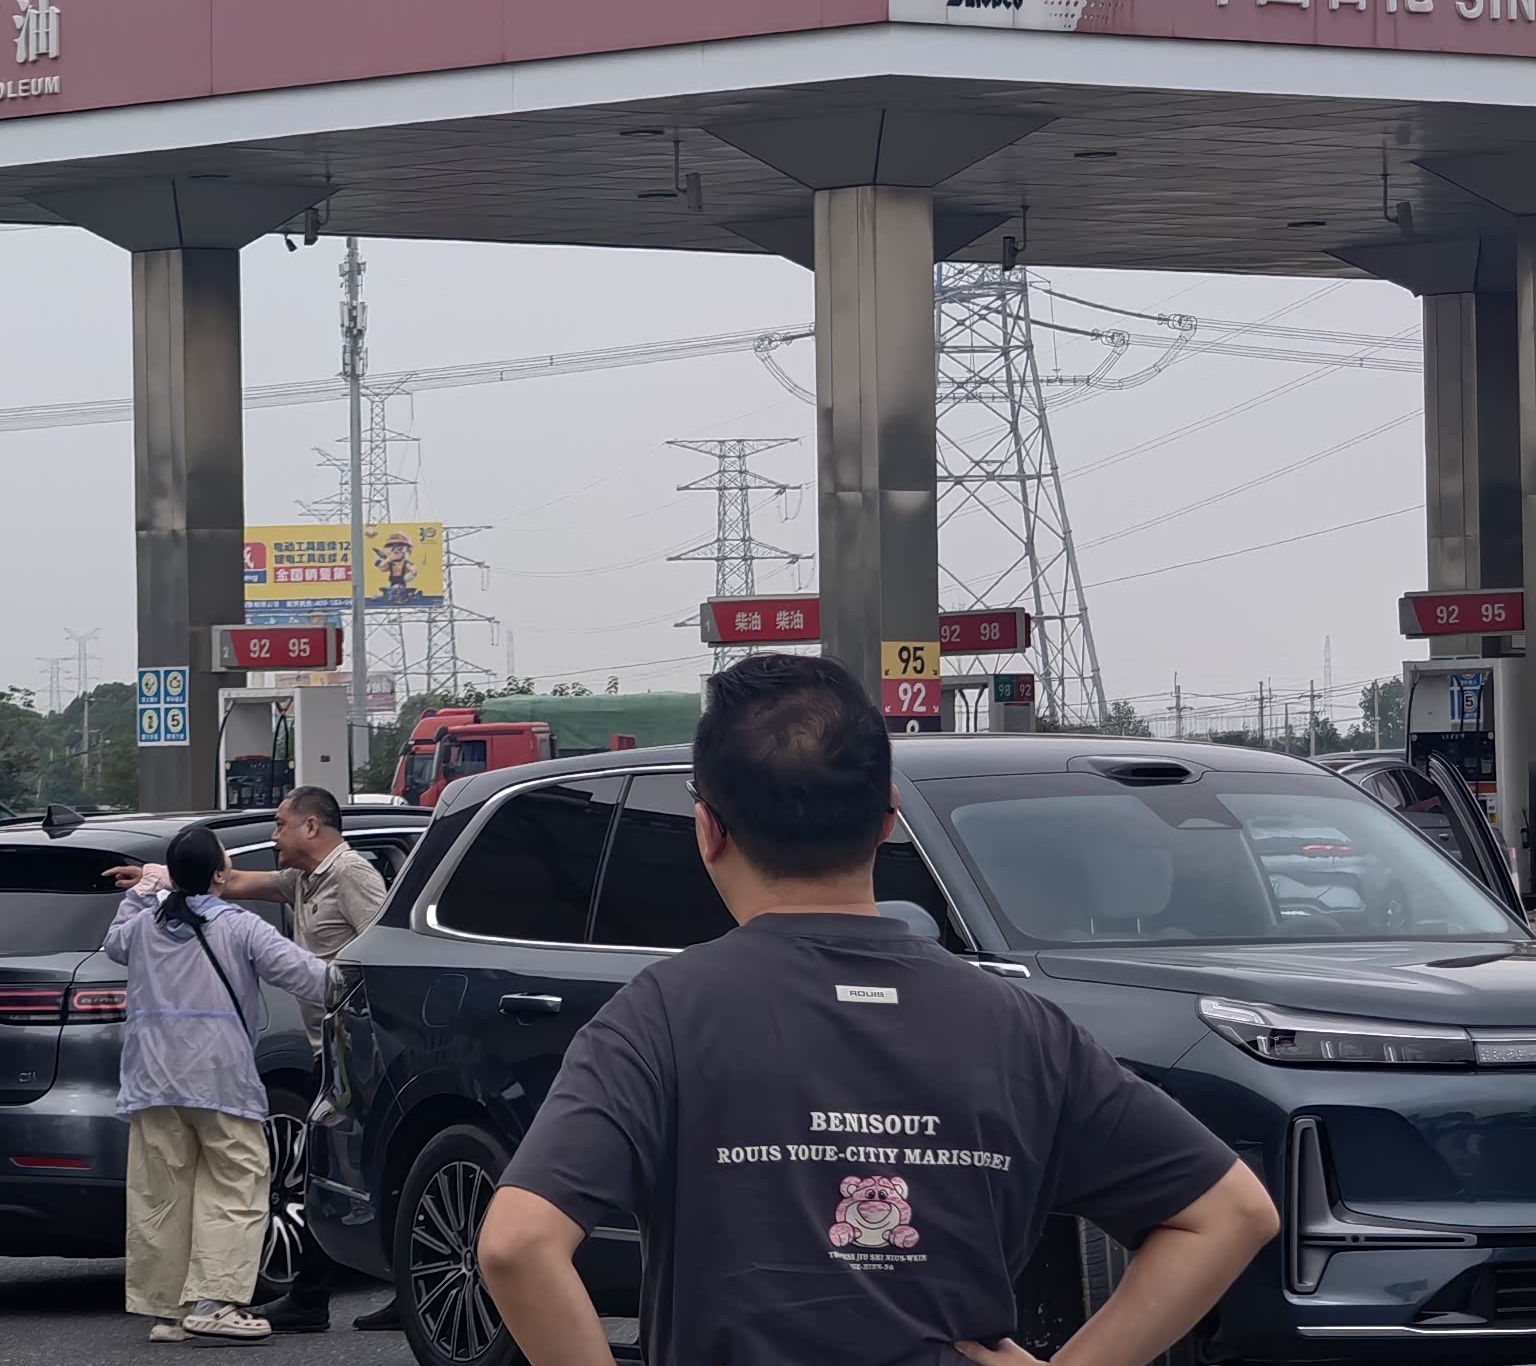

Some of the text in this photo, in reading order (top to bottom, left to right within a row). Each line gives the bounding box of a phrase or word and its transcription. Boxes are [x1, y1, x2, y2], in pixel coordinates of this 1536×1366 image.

[734, 609, 804, 632] 柴油 柴油
[1436, 603, 1506, 624] 92 95
[940, 622, 1000, 643] 92 98
[249, 638, 271, 658] 92
[288, 638, 311, 657] 95
[898, 645, 925, 675] 95
[898, 682, 926, 713] 92
[998, 684, 1011, 697] 98
[1019, 684, 1032, 697] 92
[1465, 695, 1474, 708] 5
[171, 713, 180, 728] 5
[809, 1111, 941, 1136] BENISOUT
[716, 1144, 782, 1164] ROUIS
[902, 1147, 1012, 1172] MARISUGEI
